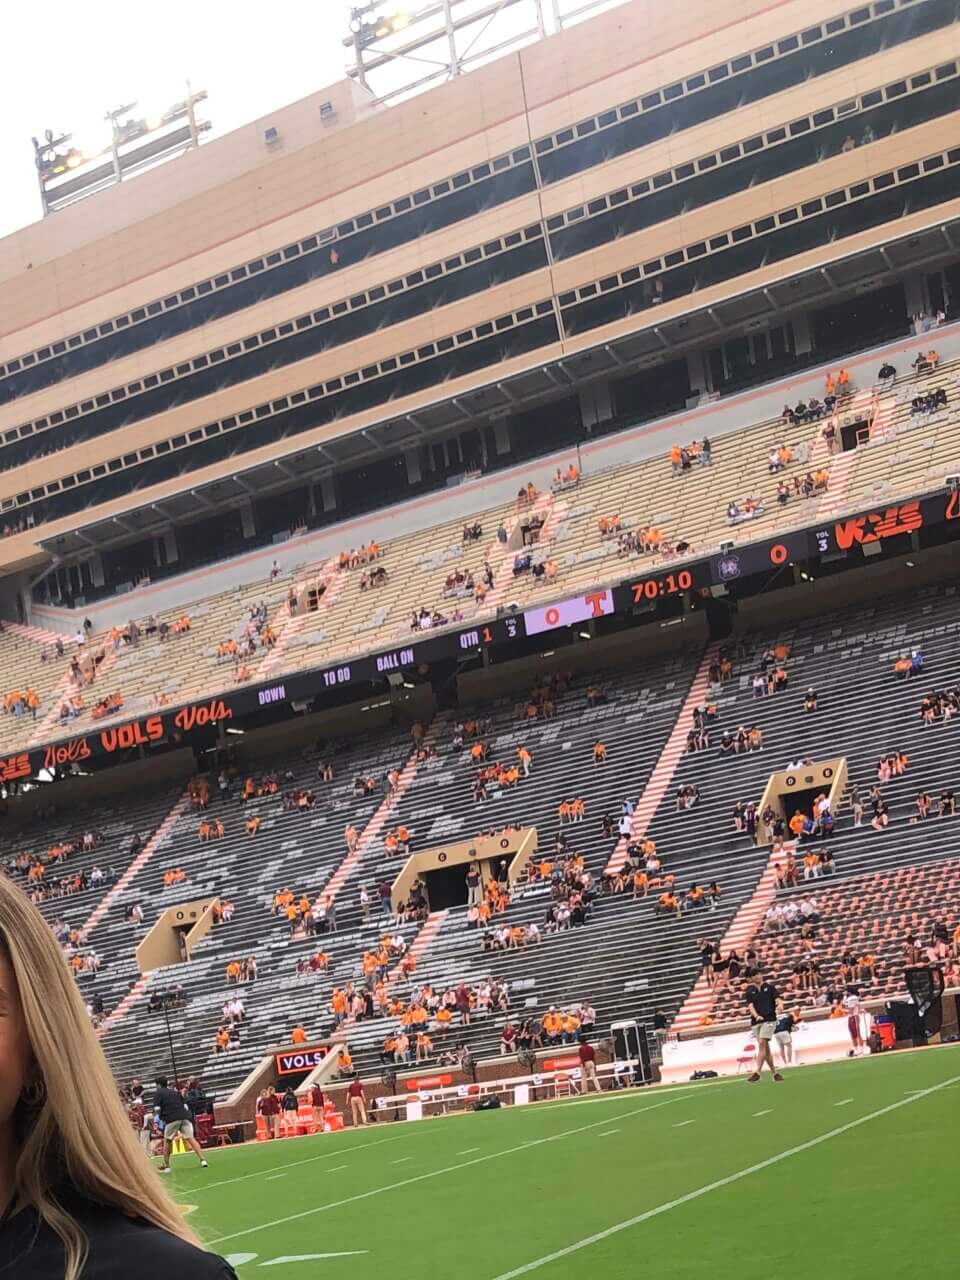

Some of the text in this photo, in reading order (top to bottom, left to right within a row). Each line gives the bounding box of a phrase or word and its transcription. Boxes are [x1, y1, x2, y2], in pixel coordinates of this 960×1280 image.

[770, 544, 788, 565] 0
[818, 539, 828, 552] 3
[631, 571, 692, 603] 70:10
[584, 591, 607, 618] T
[544, 608, 560, 625] 0
[460, 628, 493, 649] QTR 1
[507, 625, 517, 637] 3
[376, 649, 414, 672] BALL ON
[323, 672, 337, 688] TO
[258, 685, 286, 705] DOWN
[100, 715, 164, 752] VOLS
[283, 1053, 321, 1069] VOLS
